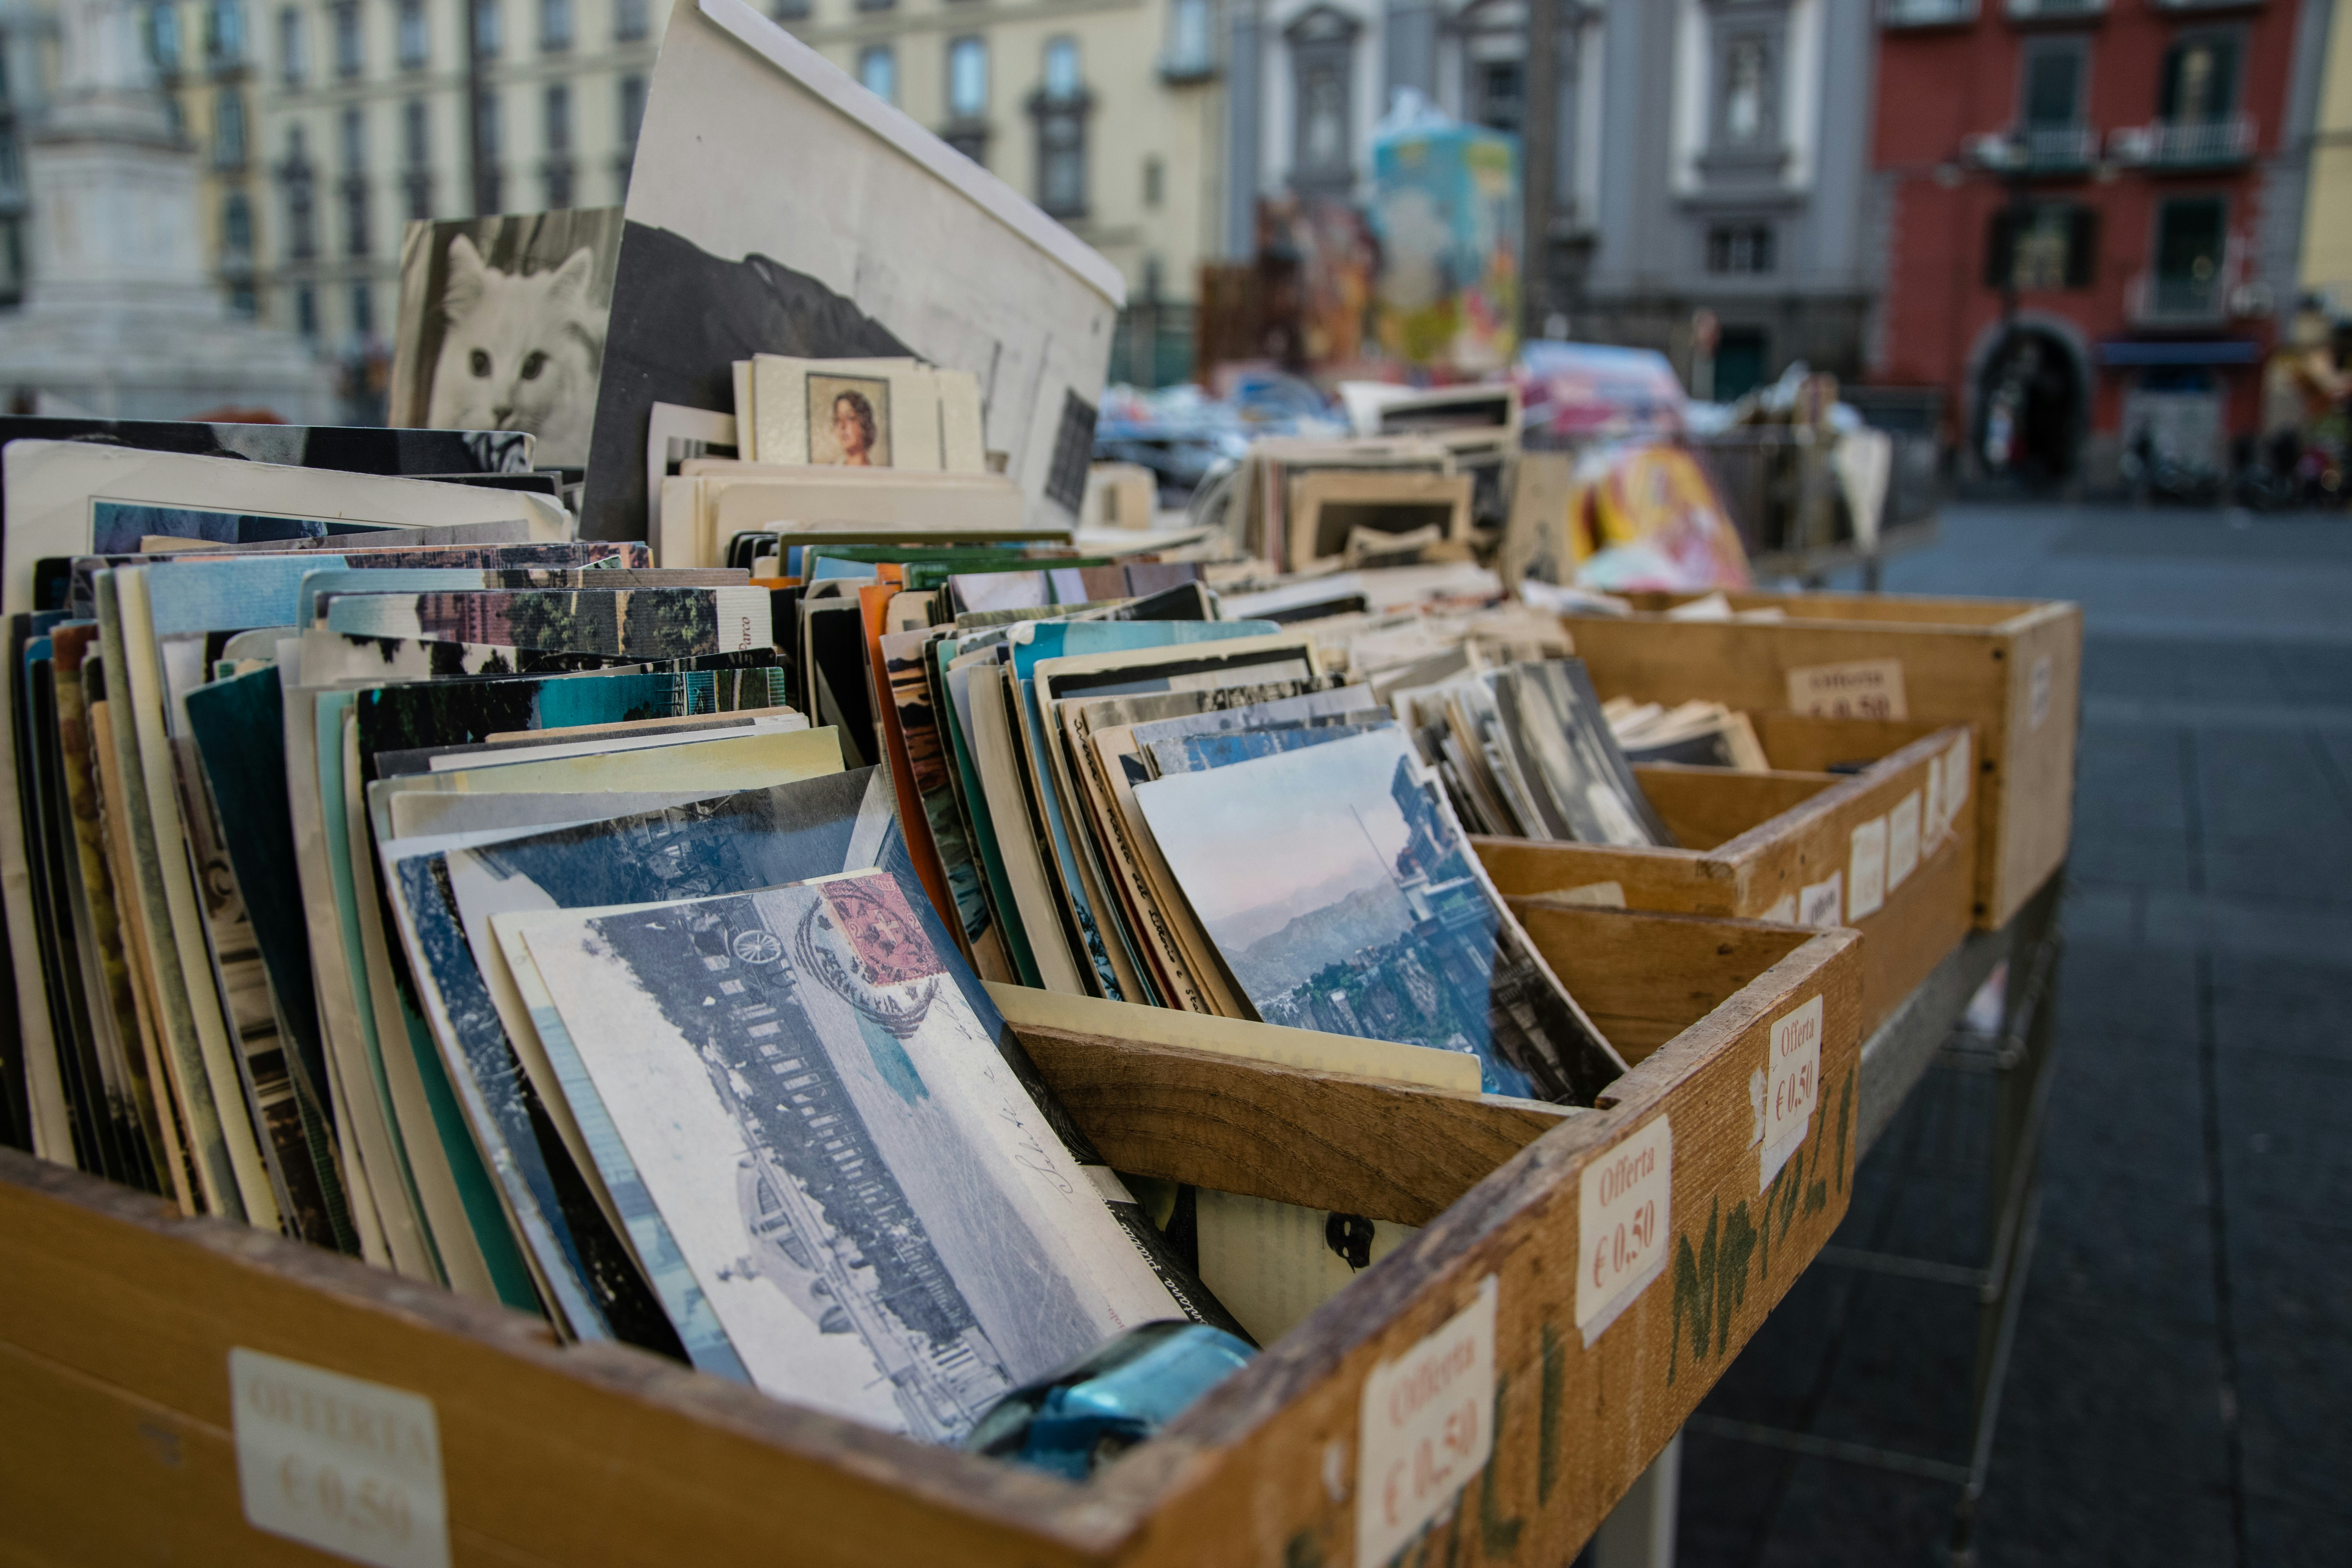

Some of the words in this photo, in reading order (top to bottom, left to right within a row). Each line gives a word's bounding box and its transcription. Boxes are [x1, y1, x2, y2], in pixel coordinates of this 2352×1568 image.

[849, 923, 862, 938] 2
[907, 913, 921, 930] 2
[1132, 873, 1148, 899] del
[1176, 970, 1182, 978] e
[1185, 989, 1201, 1014] Sta
[1780, 1014, 1815, 1058] Offerta
[1775, 1080, 1785, 1122] €
[1786, 1060, 1813, 1116] 0,50
[1600, 1145, 1655, 1207] Offerta
[1593, 1234, 1608, 1289] €
[1613, 1200, 1655, 1273] 0,50
[1164, 1277, 1209, 1326] ontana
